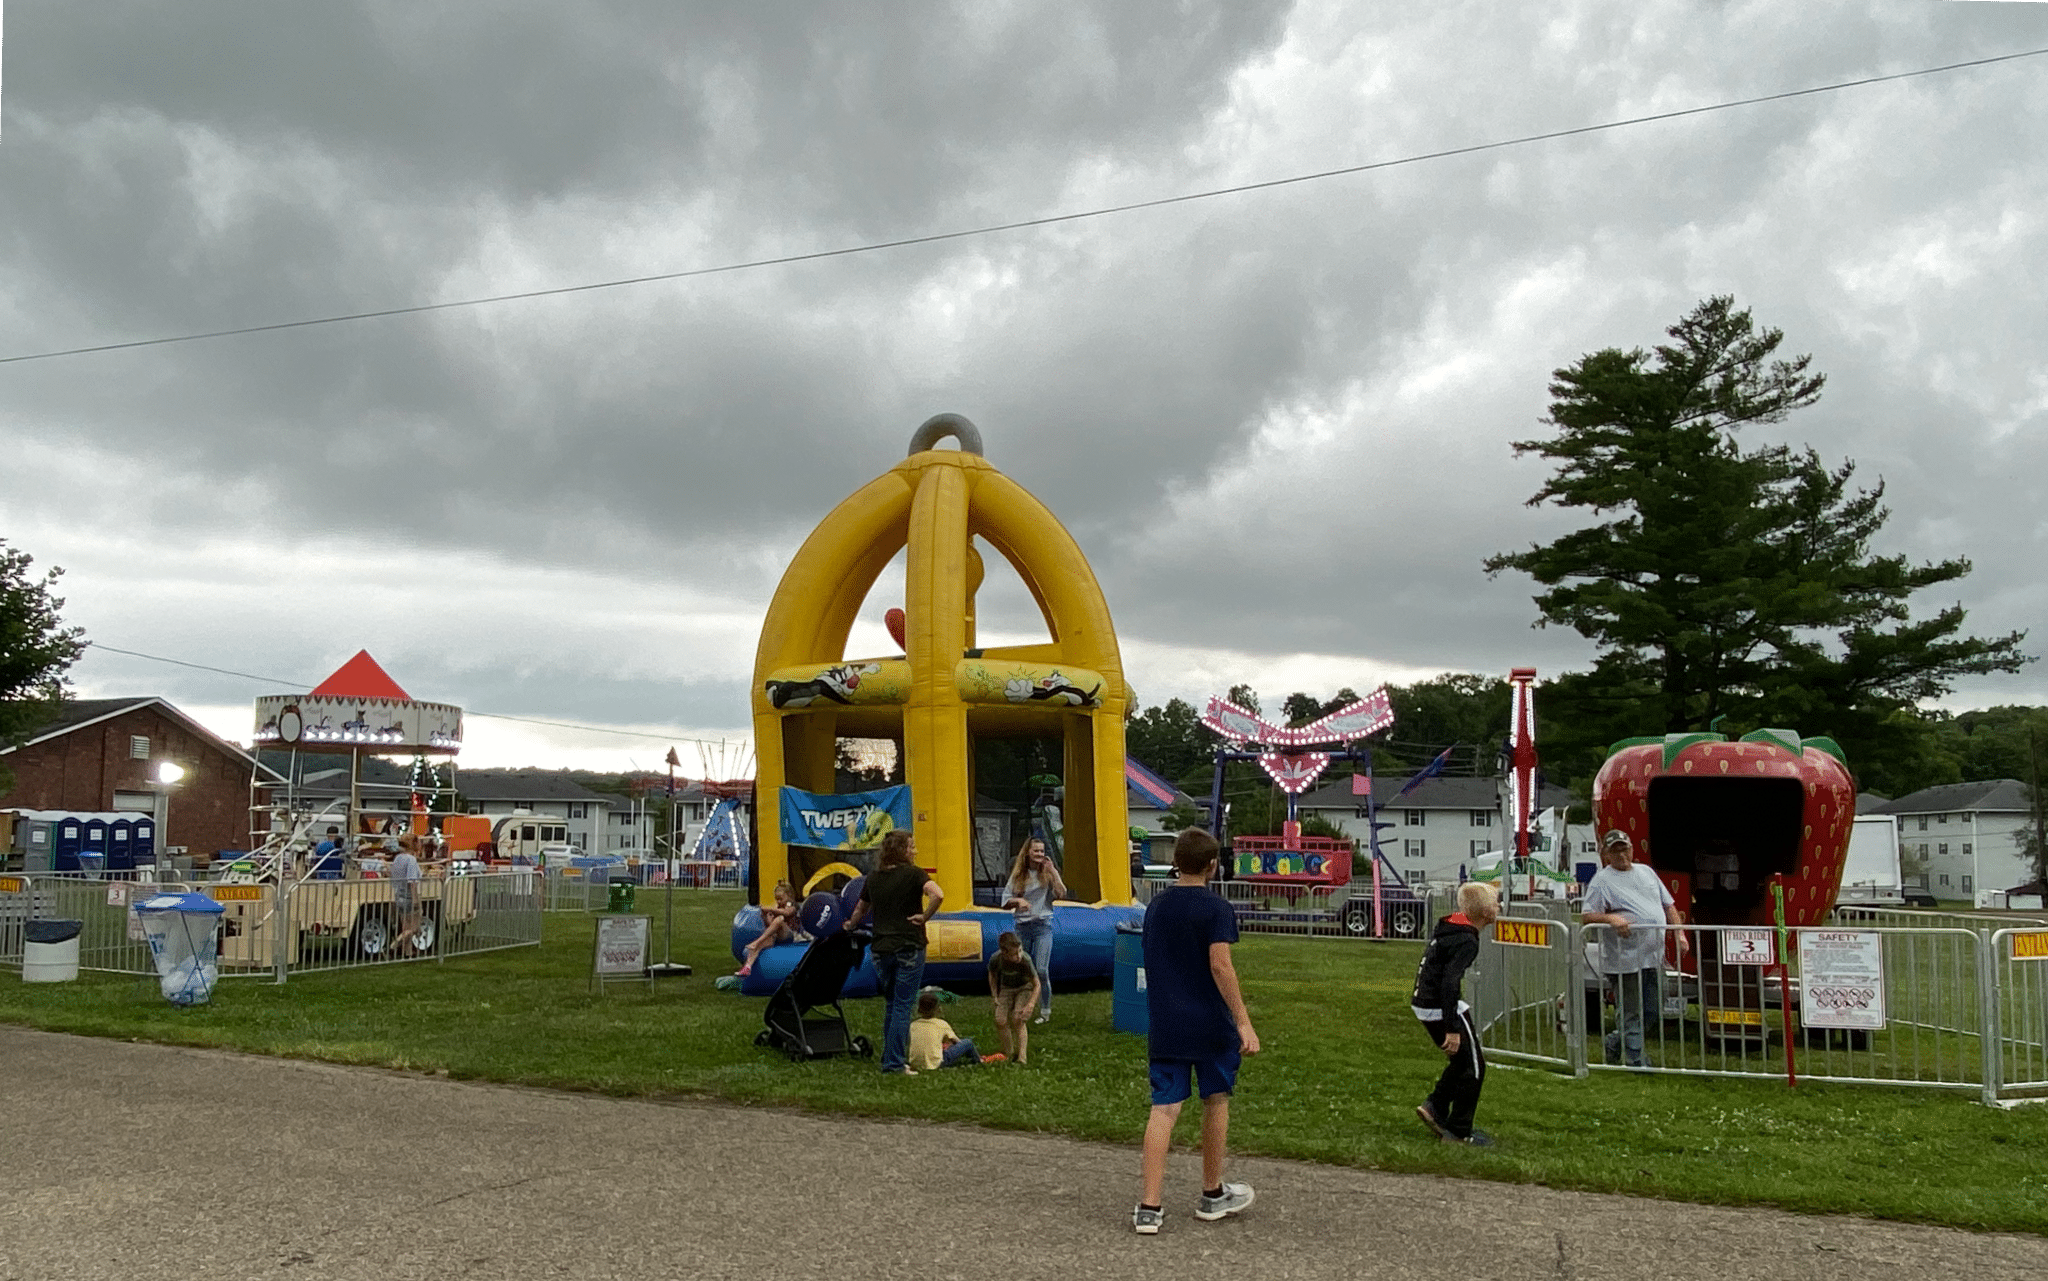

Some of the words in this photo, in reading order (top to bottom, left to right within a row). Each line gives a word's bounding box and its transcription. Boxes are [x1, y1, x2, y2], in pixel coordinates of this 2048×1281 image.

[800, 803, 875, 829] TWEETY
[1501, 921, 1543, 944] EXIT
[1728, 931, 1746, 940] THIS
[1749, 931, 1767, 940] RIDE
[1818, 933, 1858, 941] SAFETY
[1740, 940, 1755, 953] 3
[1729, 953, 1767, 961] TICKETS
